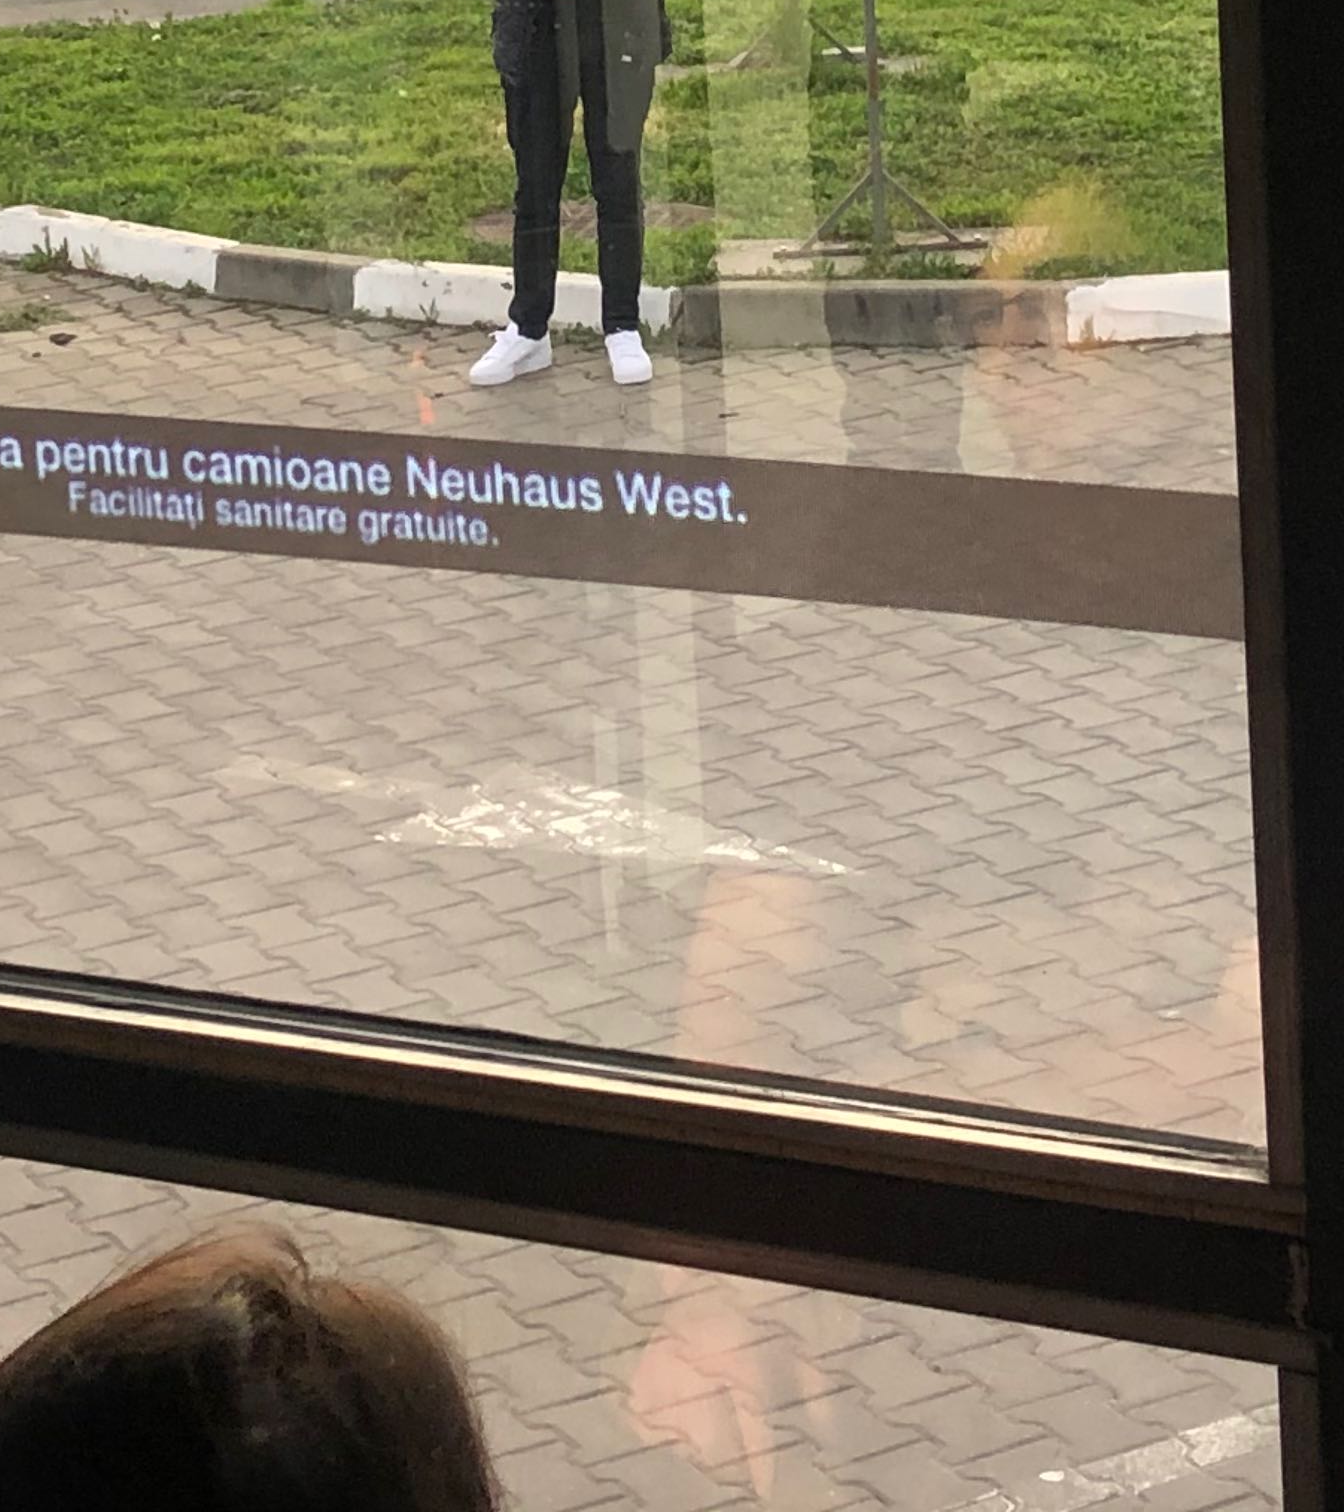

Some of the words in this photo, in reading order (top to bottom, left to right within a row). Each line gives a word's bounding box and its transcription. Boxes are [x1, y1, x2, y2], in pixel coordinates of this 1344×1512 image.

[36, 436, 169, 480] pentru
[182, 446, 392, 497] camioane
[406, 456, 604, 513] Neuhaus
[614, 470, 749, 525] West.
[215, 496, 348, 535] sanitare
[358, 505, 500, 548] gratuite.
